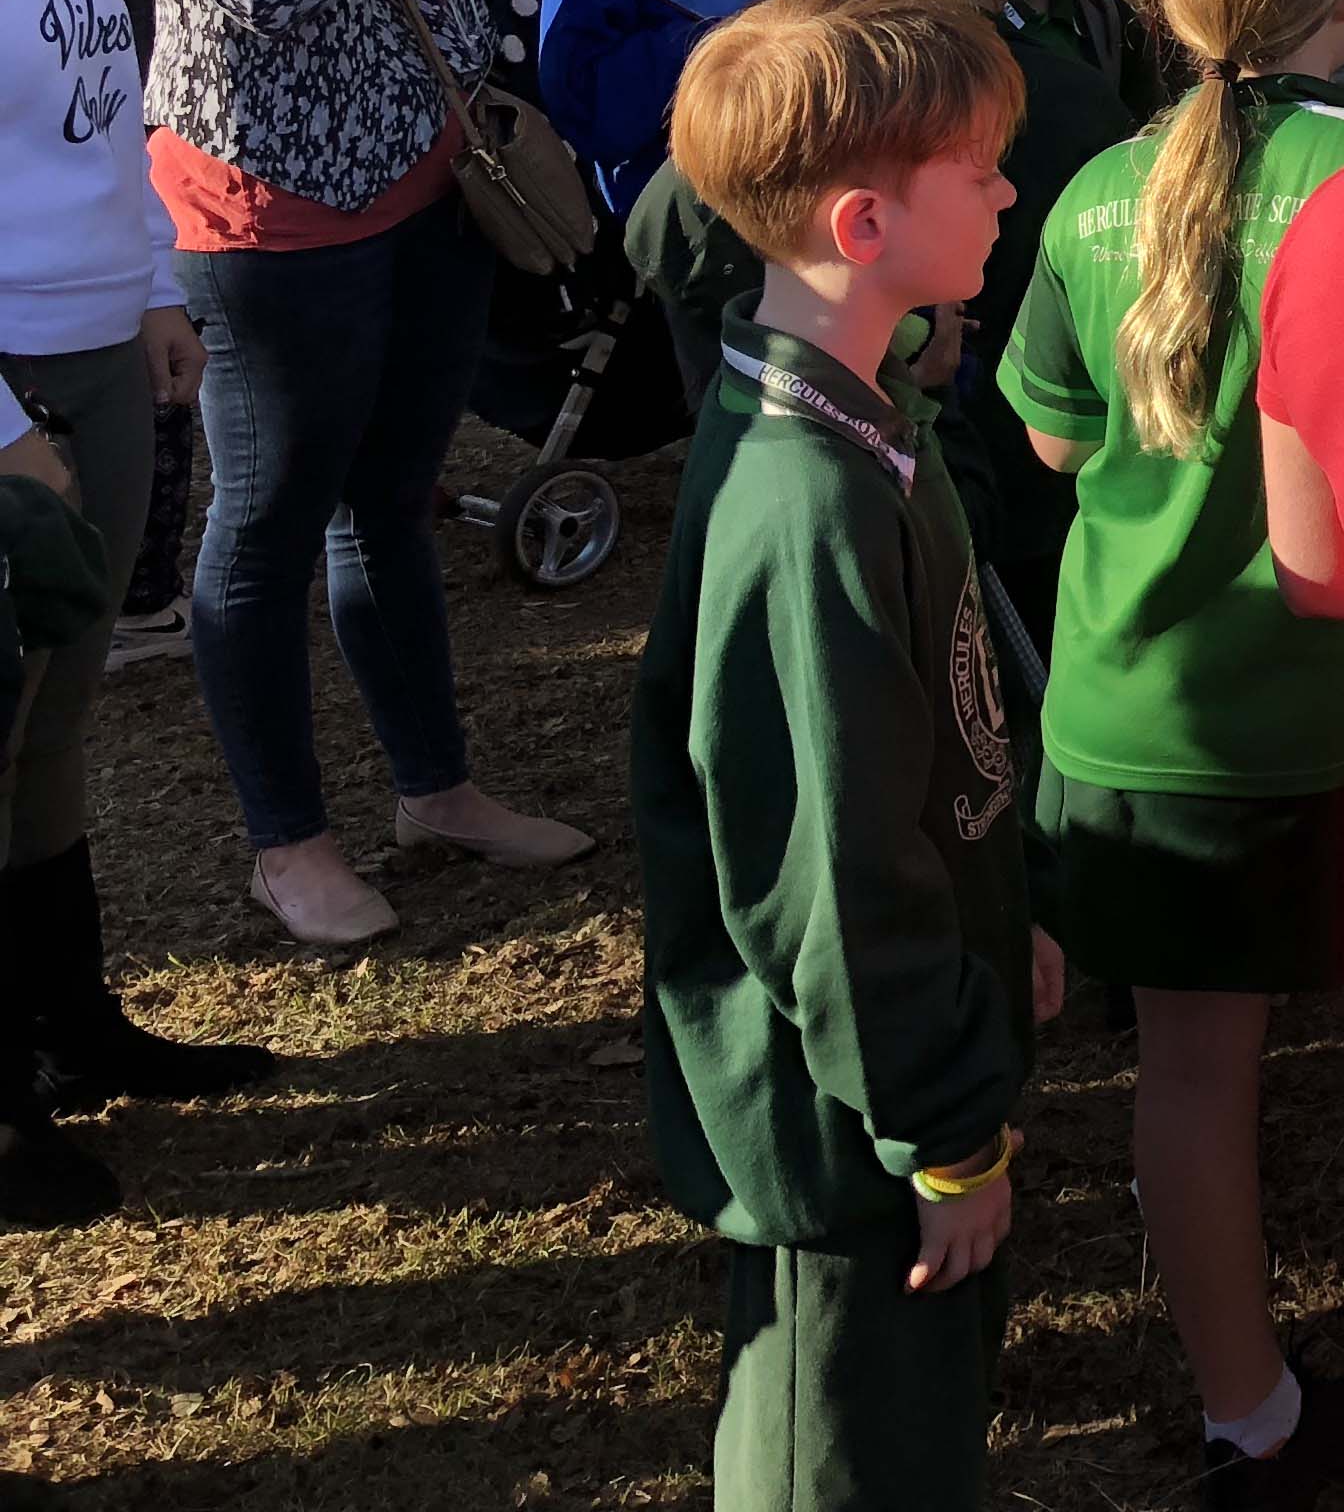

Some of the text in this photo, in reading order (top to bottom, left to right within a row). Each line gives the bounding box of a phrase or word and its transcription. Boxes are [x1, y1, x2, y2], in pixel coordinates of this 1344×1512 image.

[1078, 197, 1146, 240] HERCULE
[1268, 194, 1307, 225] SCH
[758, 364, 842, 420] HERCULES
[956, 607, 973, 721] HERCULES
